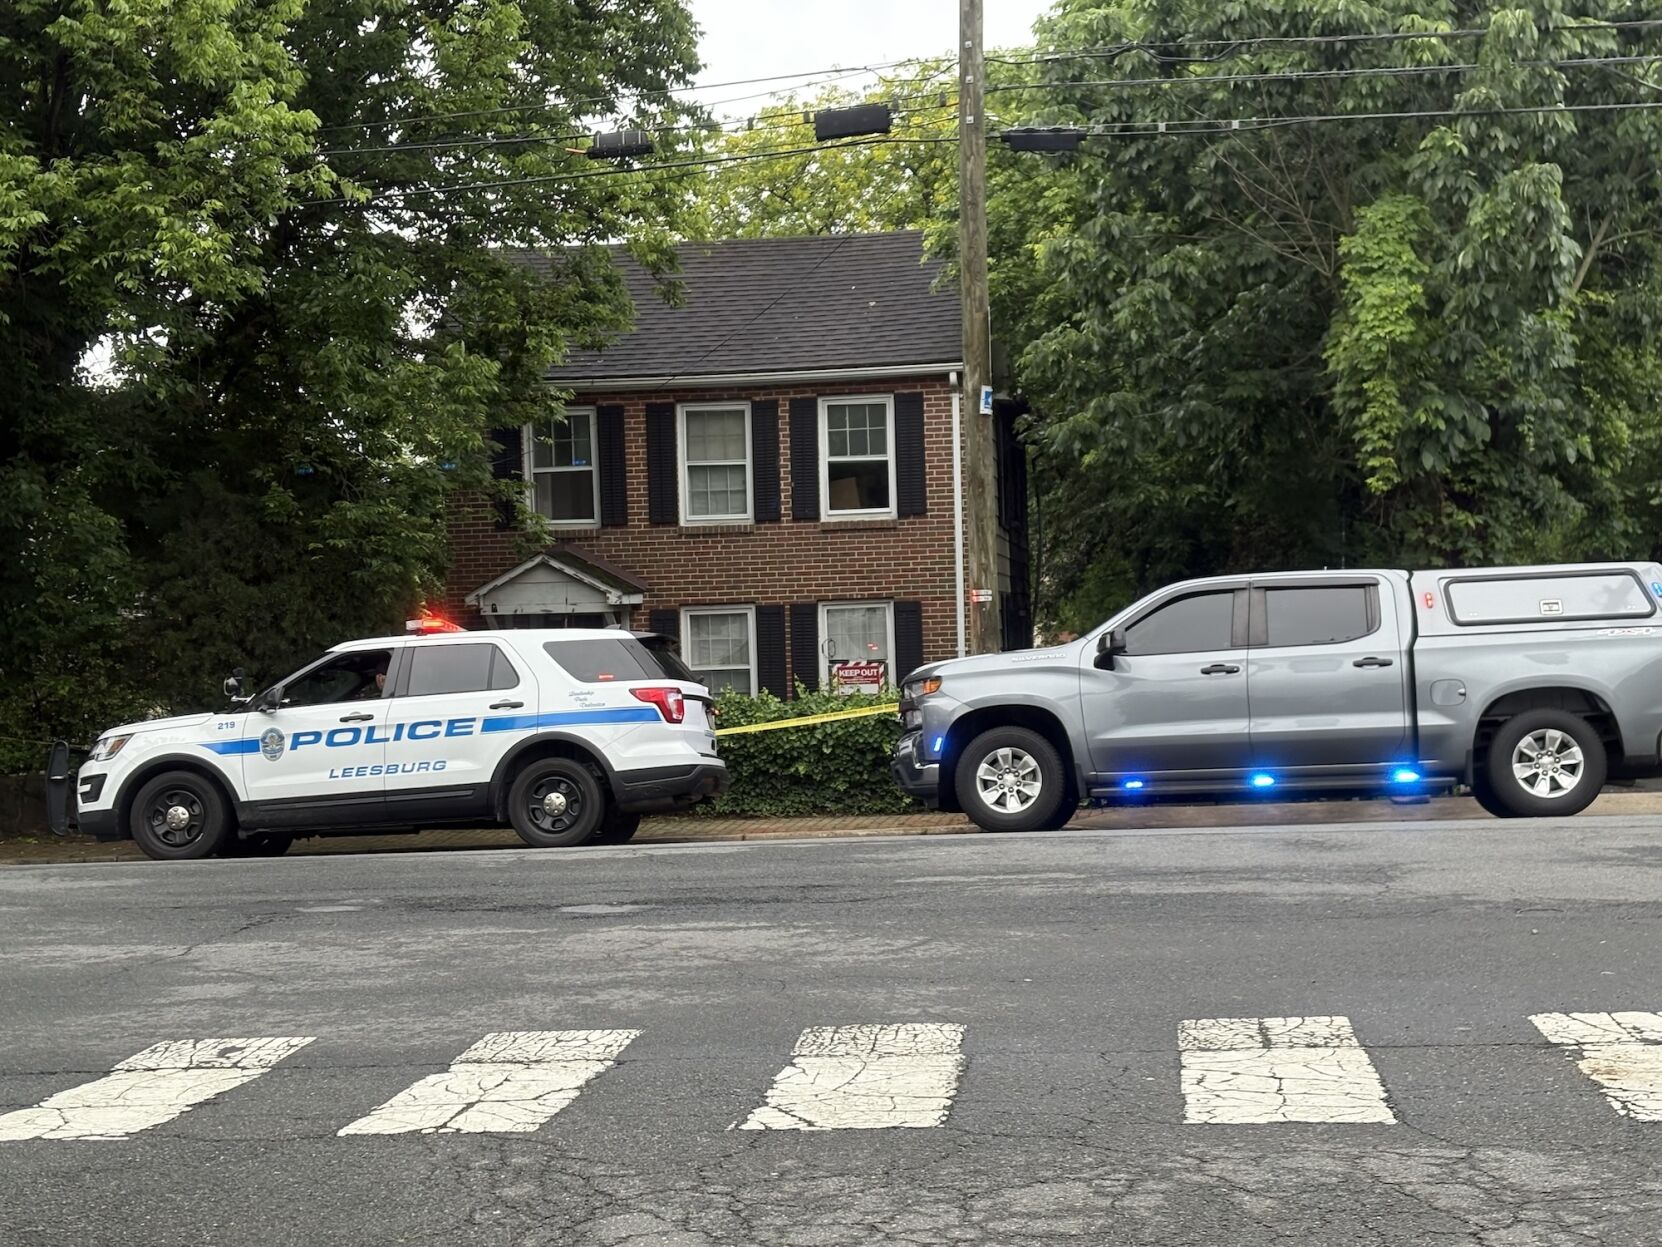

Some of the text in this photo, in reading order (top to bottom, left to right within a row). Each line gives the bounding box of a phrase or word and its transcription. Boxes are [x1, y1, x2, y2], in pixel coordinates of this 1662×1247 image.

[839, 669, 860, 677] KEEP
[217, 721, 236, 730] 219
[289, 717, 477, 751] POLICE
[329, 760, 447, 779] LEESBURG
